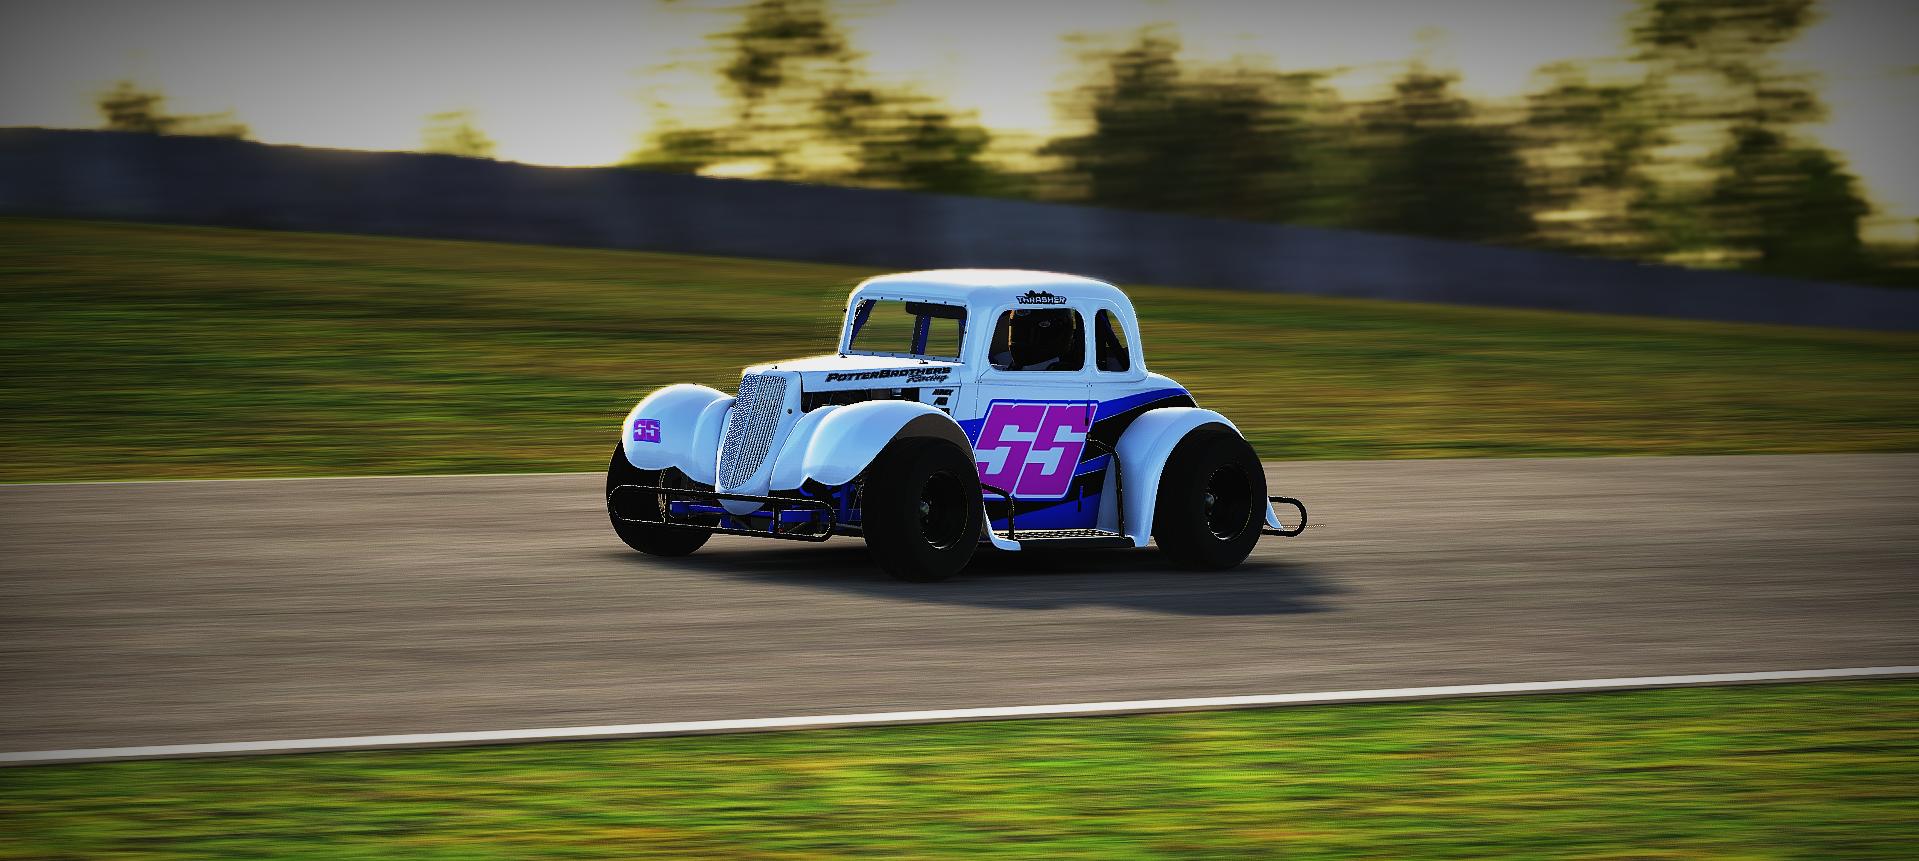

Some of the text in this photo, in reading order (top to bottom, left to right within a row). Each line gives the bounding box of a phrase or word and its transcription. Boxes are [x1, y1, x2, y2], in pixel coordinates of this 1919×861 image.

[1016, 296, 1067, 304] THRASHER
[633, 419, 660, 443] 55
[974, 402, 1098, 499] 55
